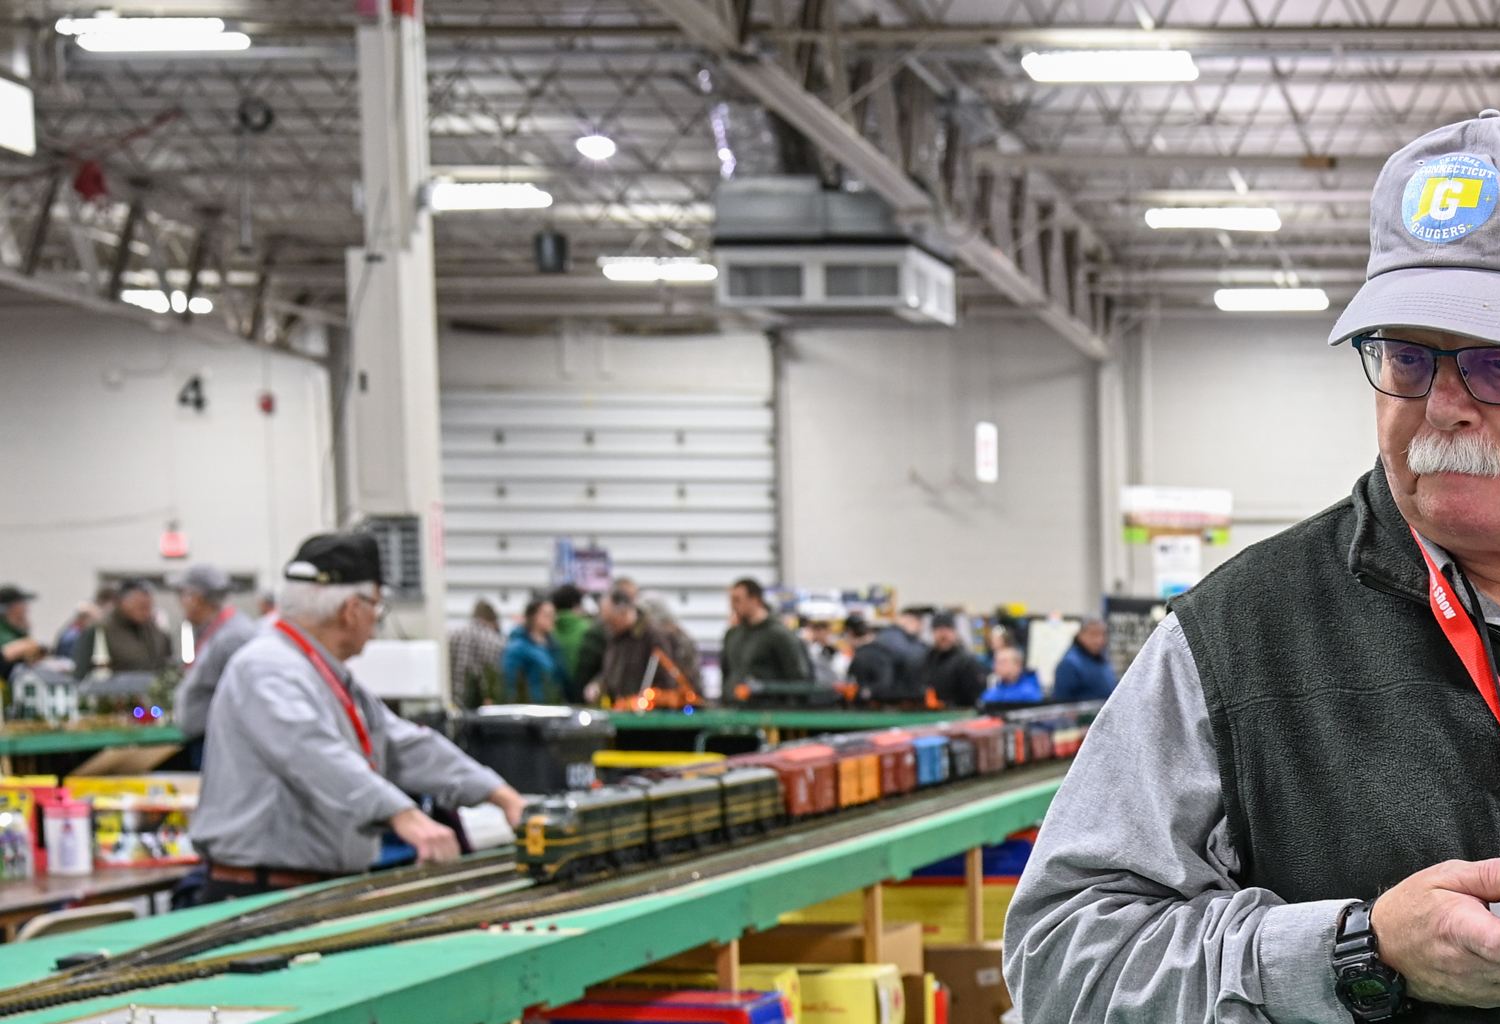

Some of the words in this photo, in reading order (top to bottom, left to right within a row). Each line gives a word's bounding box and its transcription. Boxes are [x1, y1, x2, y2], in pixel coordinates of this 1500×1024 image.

[1420, 164, 1496, 179] CONNECTICUT
[1439, 156, 1481, 167] CENTRAL
[1429, 179, 1464, 221] G
[1411, 222, 1467, 239] GAUGERS
[178, 375, 208, 413] 4
[1433, 585, 1457, 620] Show
